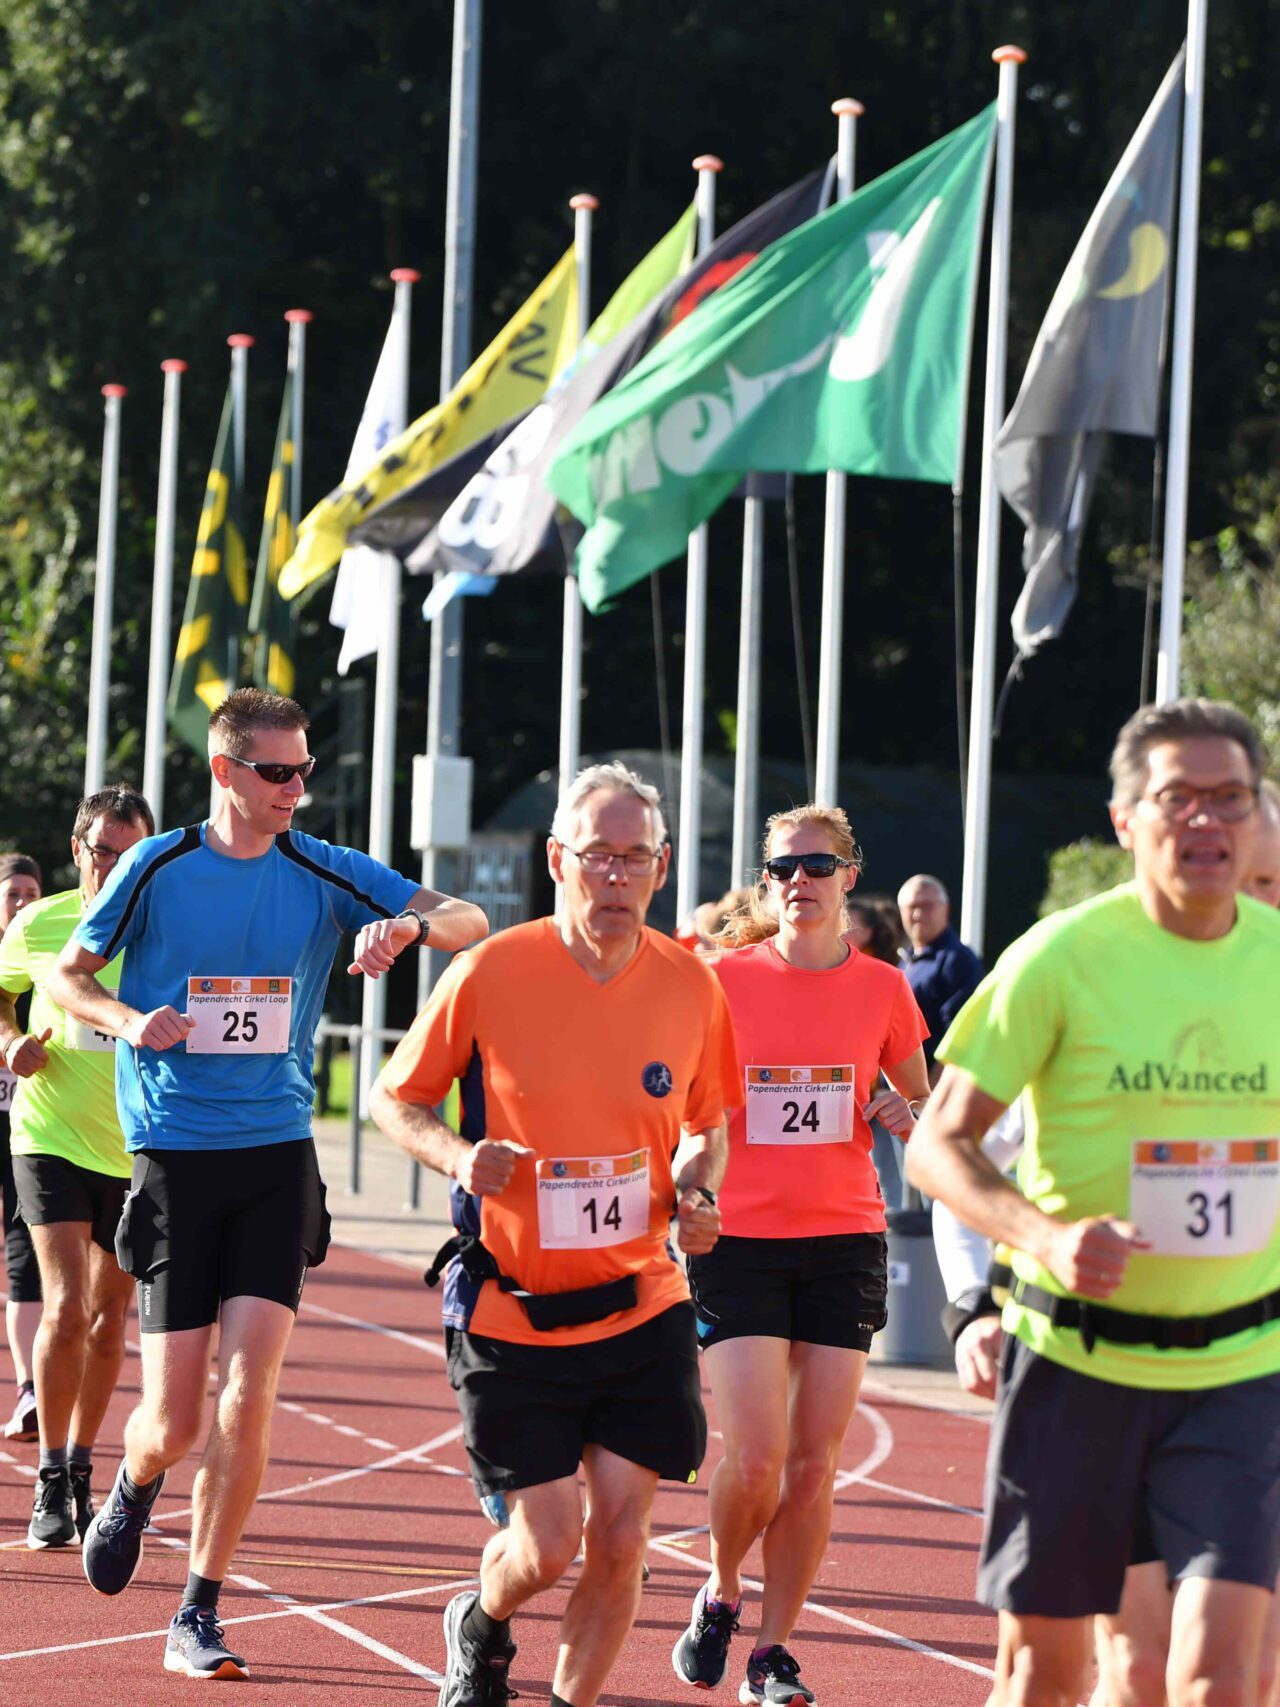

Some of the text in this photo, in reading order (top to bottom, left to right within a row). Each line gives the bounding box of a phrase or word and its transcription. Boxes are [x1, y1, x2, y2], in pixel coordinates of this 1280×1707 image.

[189, 994, 289, 1004] Papendrecht Cirkel Loop
[222, 1010, 259, 1042] 25
[747, 1084, 852, 1094] Papendrecht Cirkel Loop
[1106, 1060, 1268, 1093] AdVanced
[782, 1100, 820, 1133] 24
[539, 1179, 604, 1191] Papendrecht
[606, 1176, 631, 1188] Cirkel
[582, 1194, 622, 1234] 14
[1185, 1189, 1233, 1239] 31
